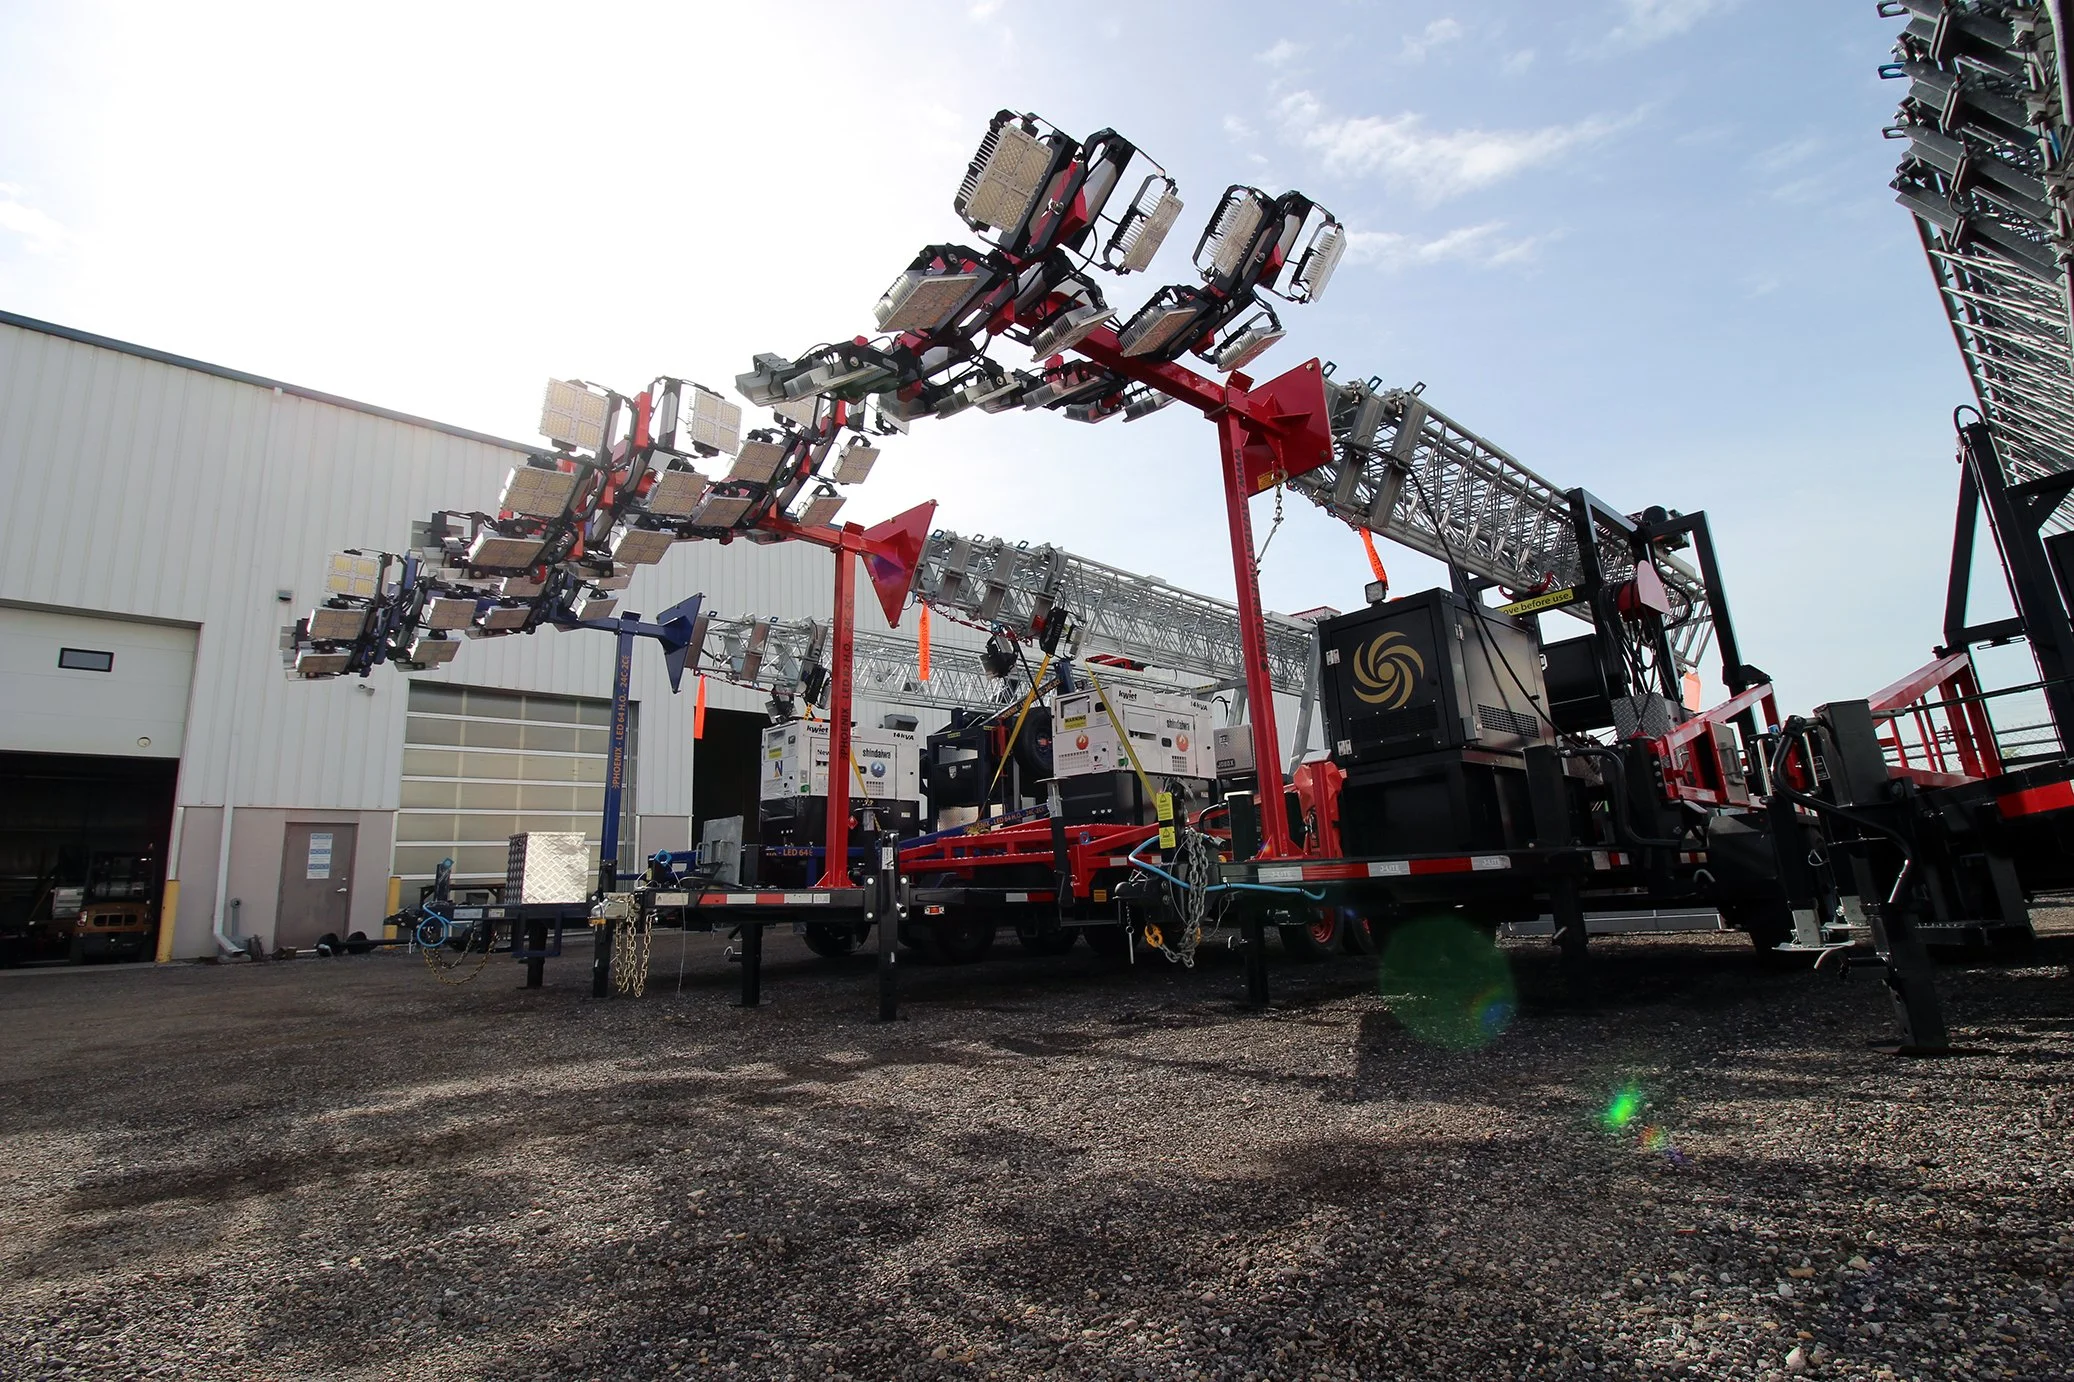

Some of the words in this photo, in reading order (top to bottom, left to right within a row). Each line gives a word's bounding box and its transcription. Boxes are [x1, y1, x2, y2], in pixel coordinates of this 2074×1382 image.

[1234, 448, 1267, 657] WWW.CANADATOWERS.COM
[1520, 598, 1551, 611] before
[1552, 592, 1572, 602] use.
[843, 641, 851, 662] H.O.
[842, 680, 850, 699] LED
[618, 693, 627, 711] H.O.
[617, 712, 625, 723] 64
[616, 724, 625, 740] LED
[806, 724, 828, 735] kwiet
[840, 708, 849, 755] PHOENIX
[893, 732, 914, 741] 14kVA
[862, 747, 891, 759] shindaiwa
[612, 747, 623, 785] PHOENIX
[783, 848, 798, 856] LED
[798, 848, 808, 856] 64
